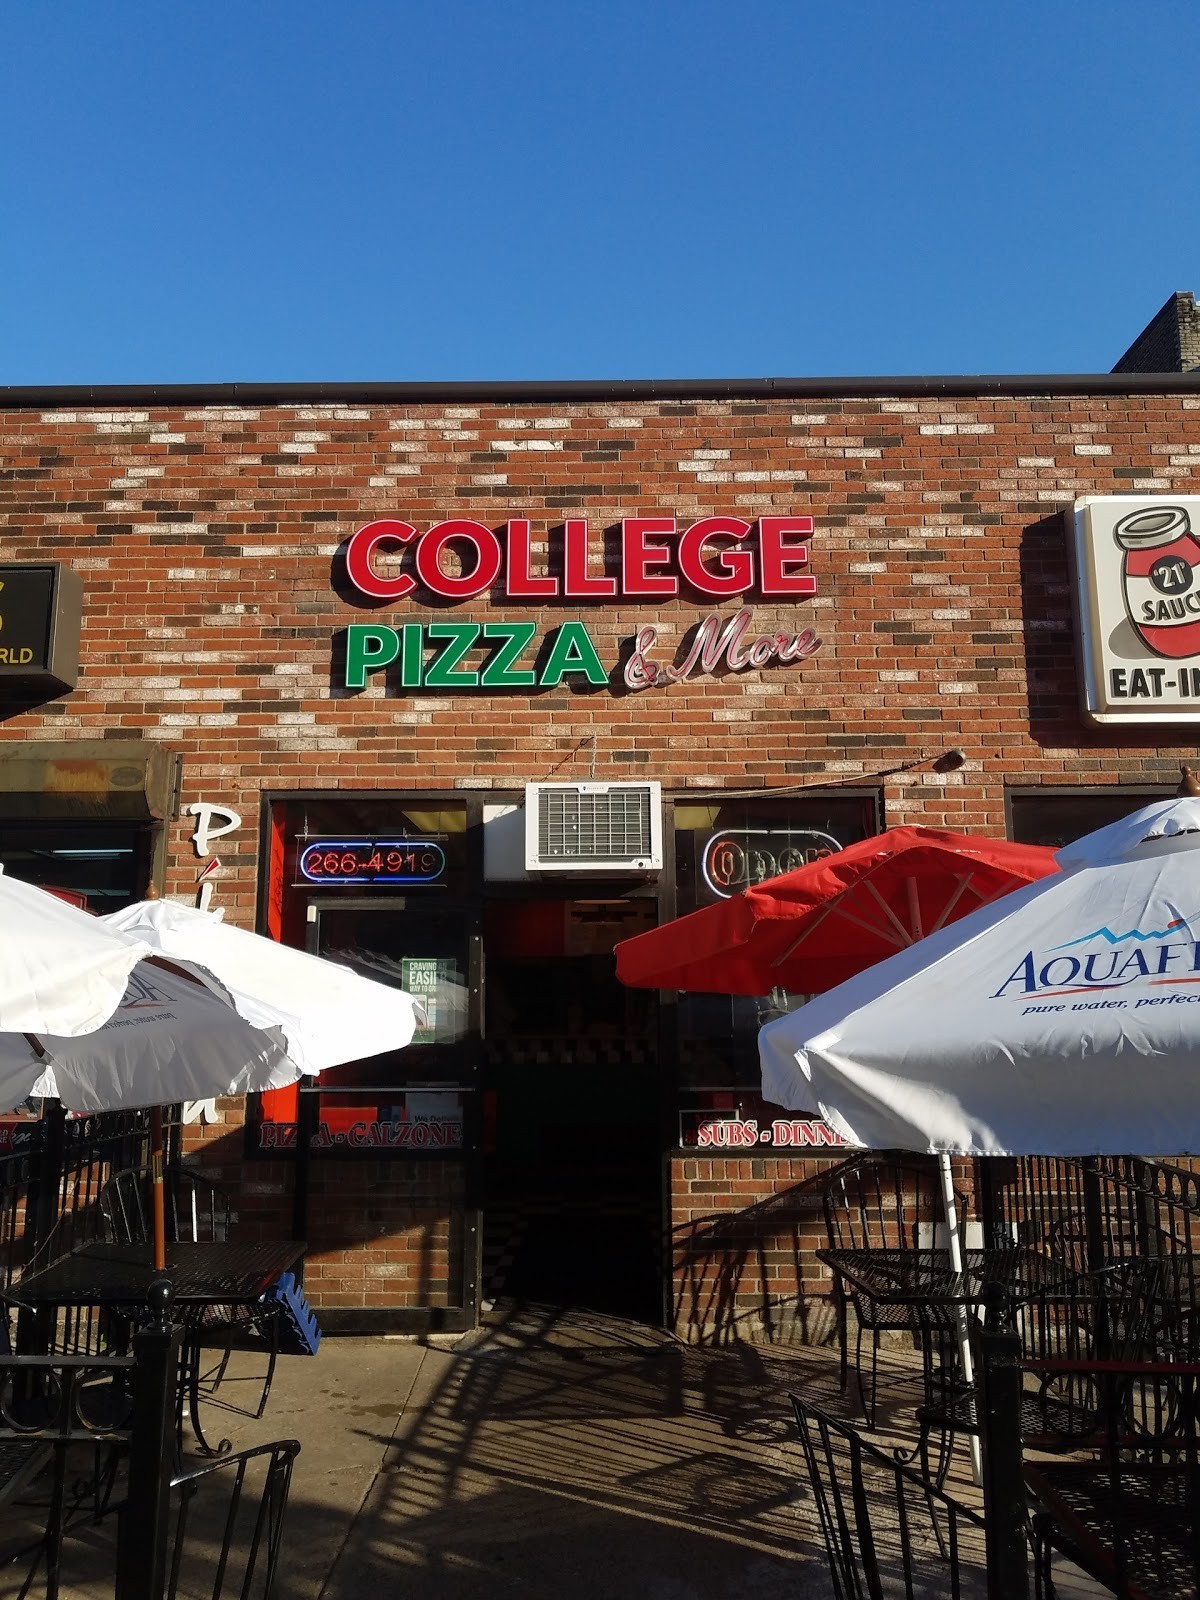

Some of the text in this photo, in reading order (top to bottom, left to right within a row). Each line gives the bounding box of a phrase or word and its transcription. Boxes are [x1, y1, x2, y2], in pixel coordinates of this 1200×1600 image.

[346, 515, 818, 599] COLLEGE
[345, 606, 823, 690] PIZZA & More
[306, 850, 436, 874] 266-4919
[409, 961, 437, 971] CRAVING
[1021, 1001, 1066, 1016] pure
[1071, 999, 1128, 1012] water,
[259, 1121, 334, 1147] PIZA
[697, 1120, 758, 1147] SUBS
